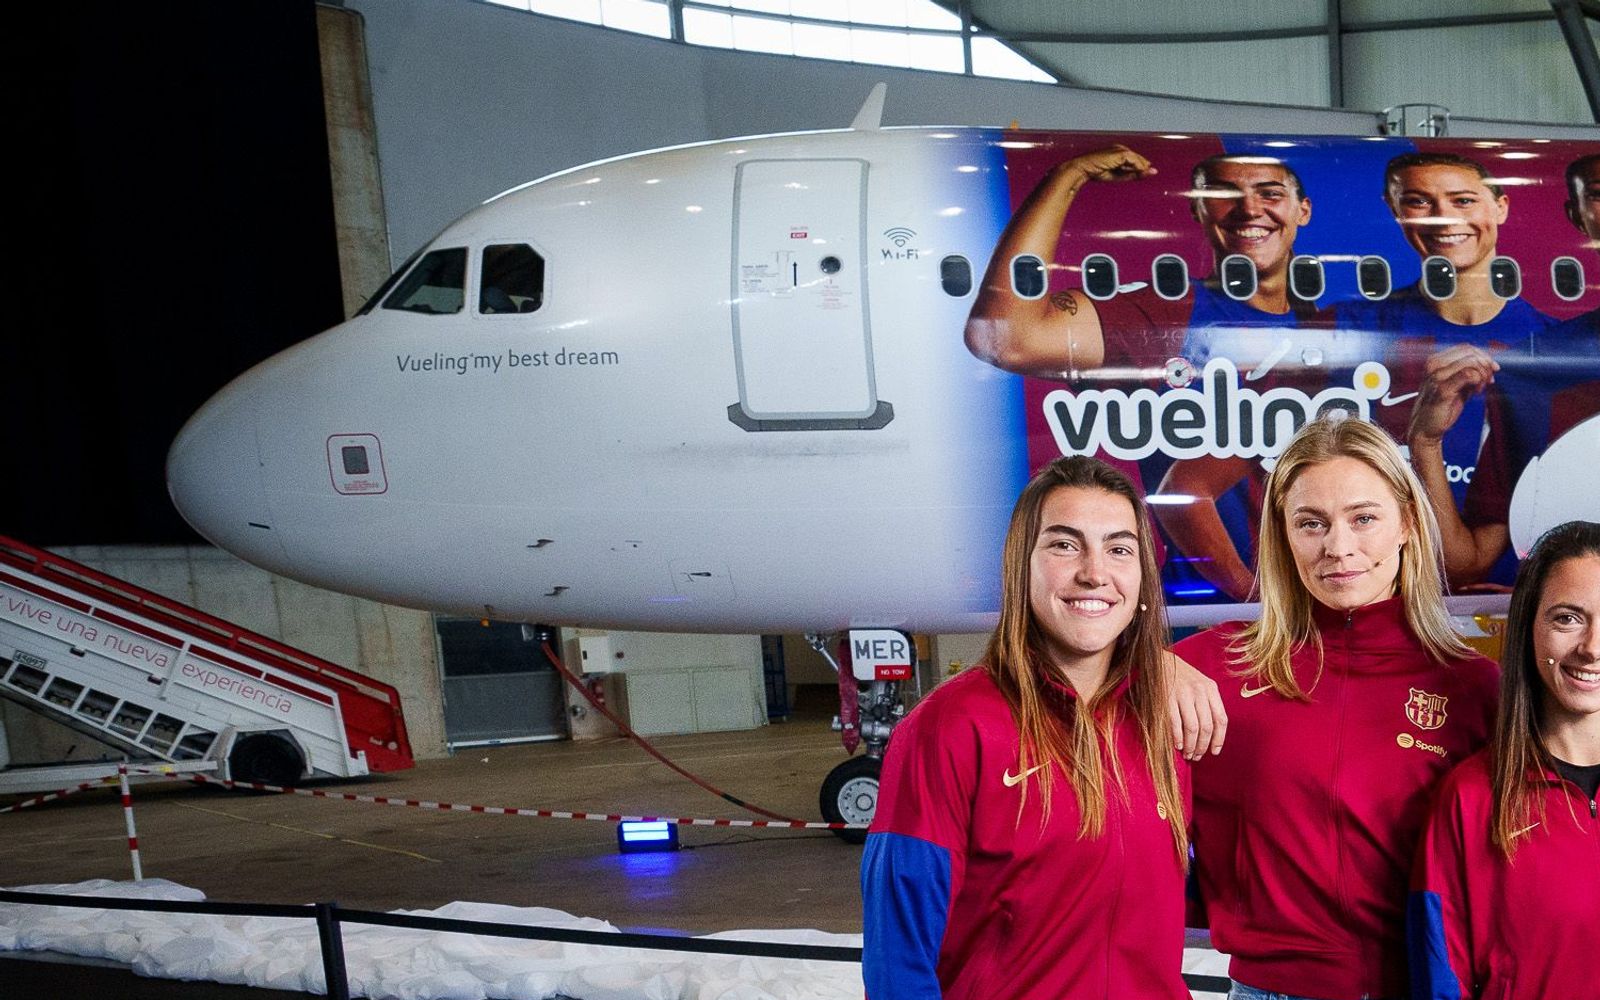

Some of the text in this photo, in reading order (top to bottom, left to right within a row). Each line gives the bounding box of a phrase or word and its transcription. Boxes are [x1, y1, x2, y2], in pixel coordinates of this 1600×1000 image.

[396, 346, 619, 375] Vueling my best dream
[9, 598, 293, 714] vive una nueva experiencia
[855, 639, 905, 660] MER
[1415, 739, 1448, 758] Spotify
